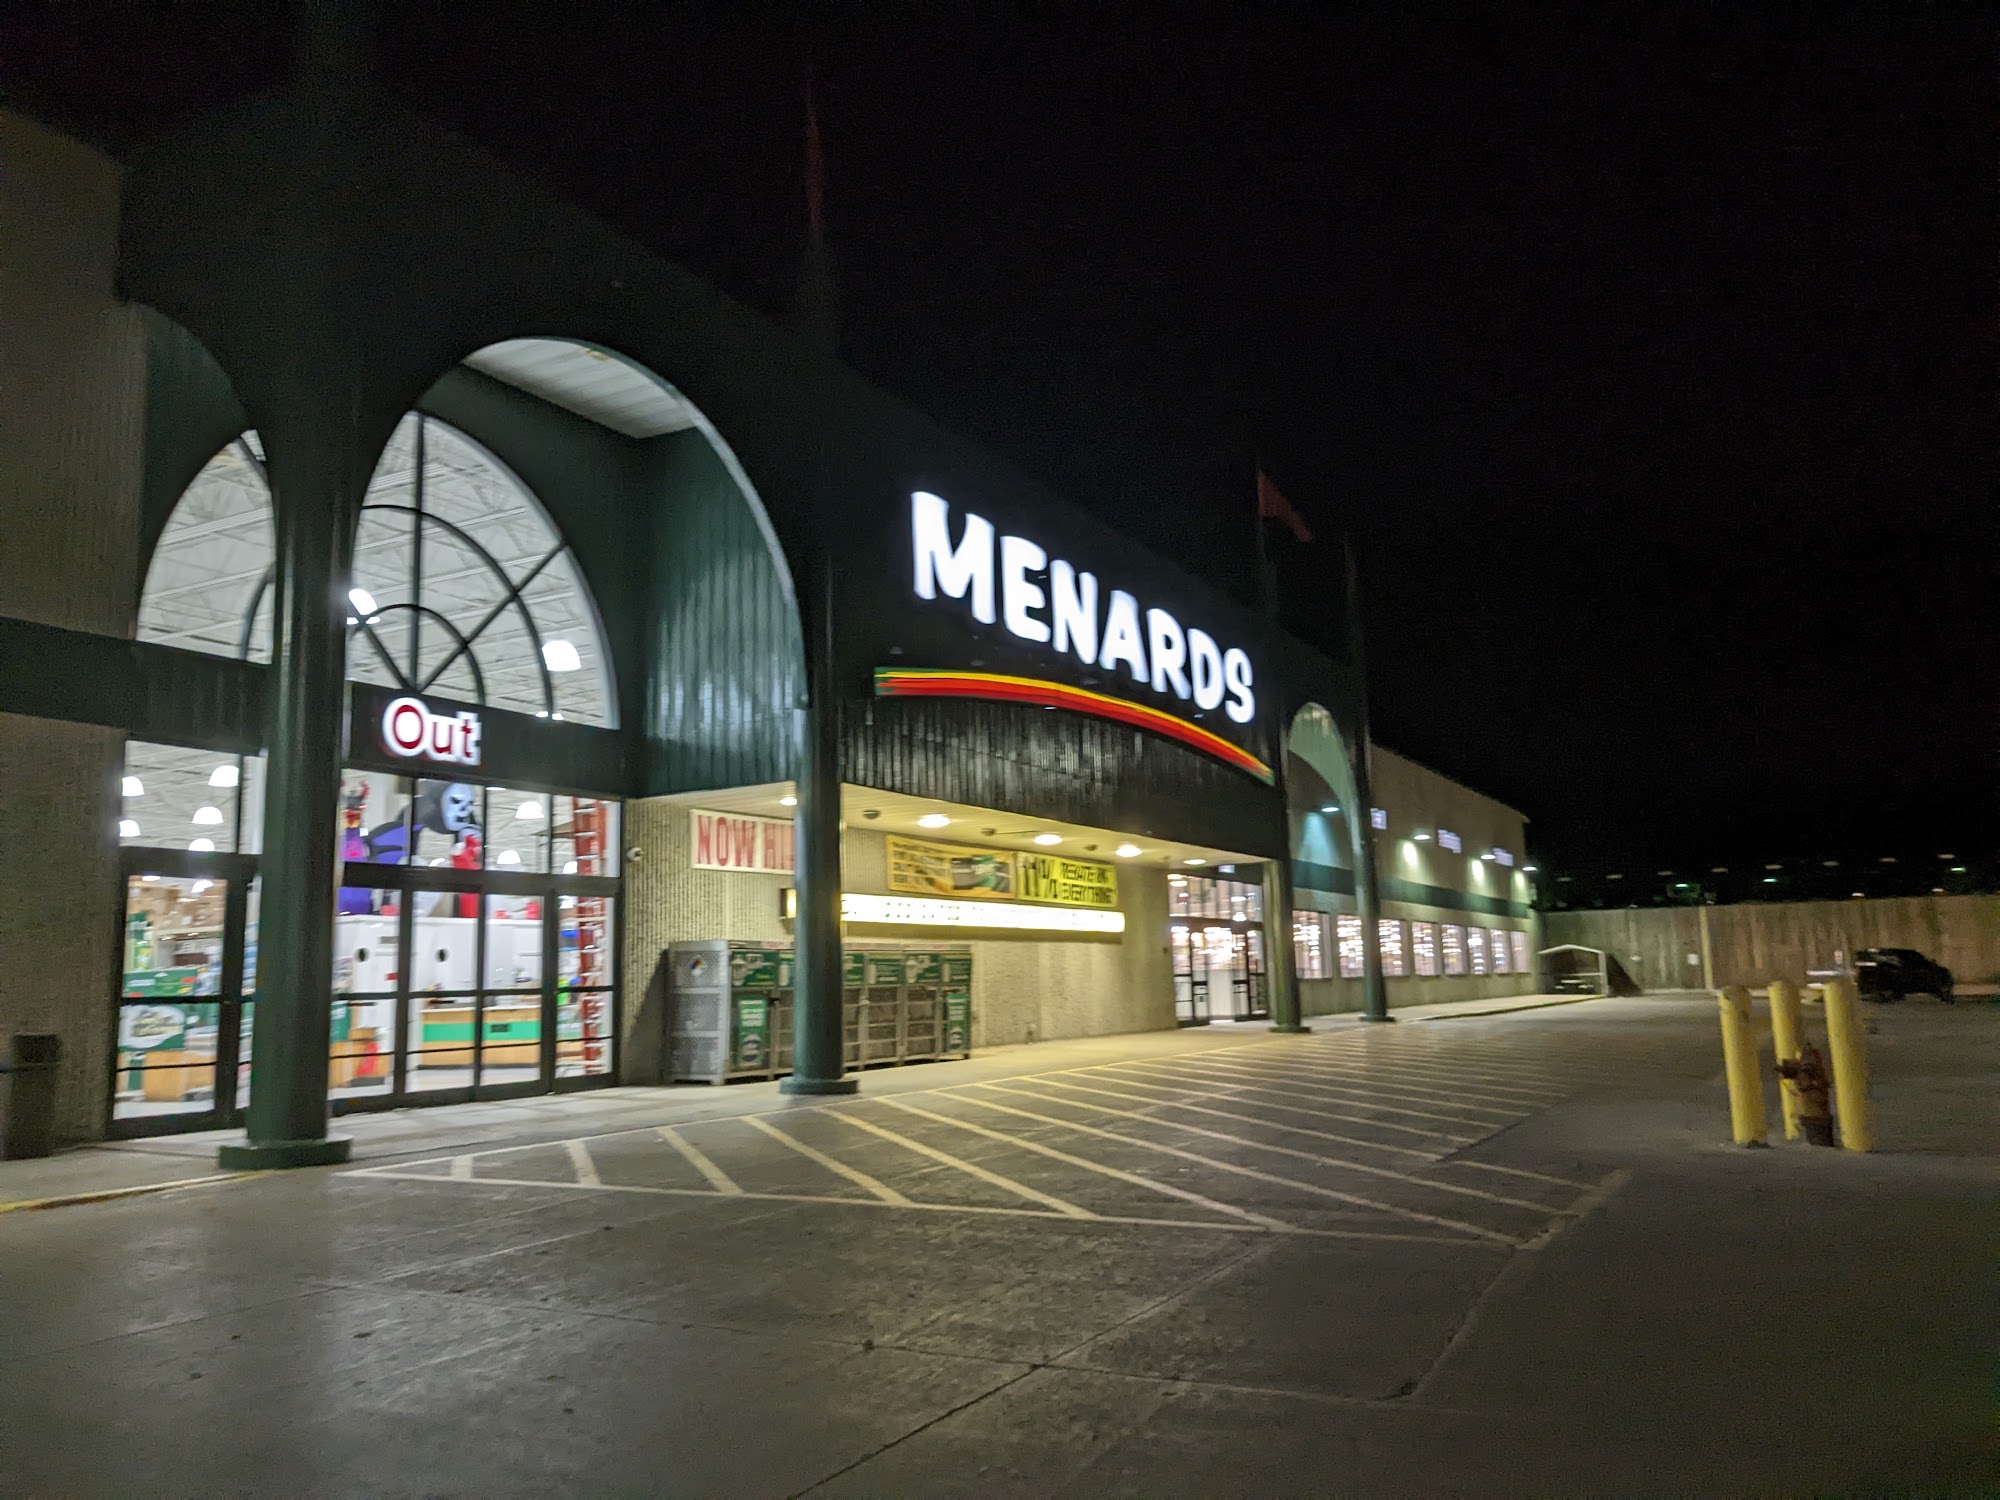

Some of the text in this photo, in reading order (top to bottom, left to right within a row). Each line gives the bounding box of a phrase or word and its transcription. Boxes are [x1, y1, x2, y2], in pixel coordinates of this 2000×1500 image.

[911, 491, 1255, 723] MENARDS
[385, 698, 480, 764] Out
[698, 815, 757, 868] NOW
